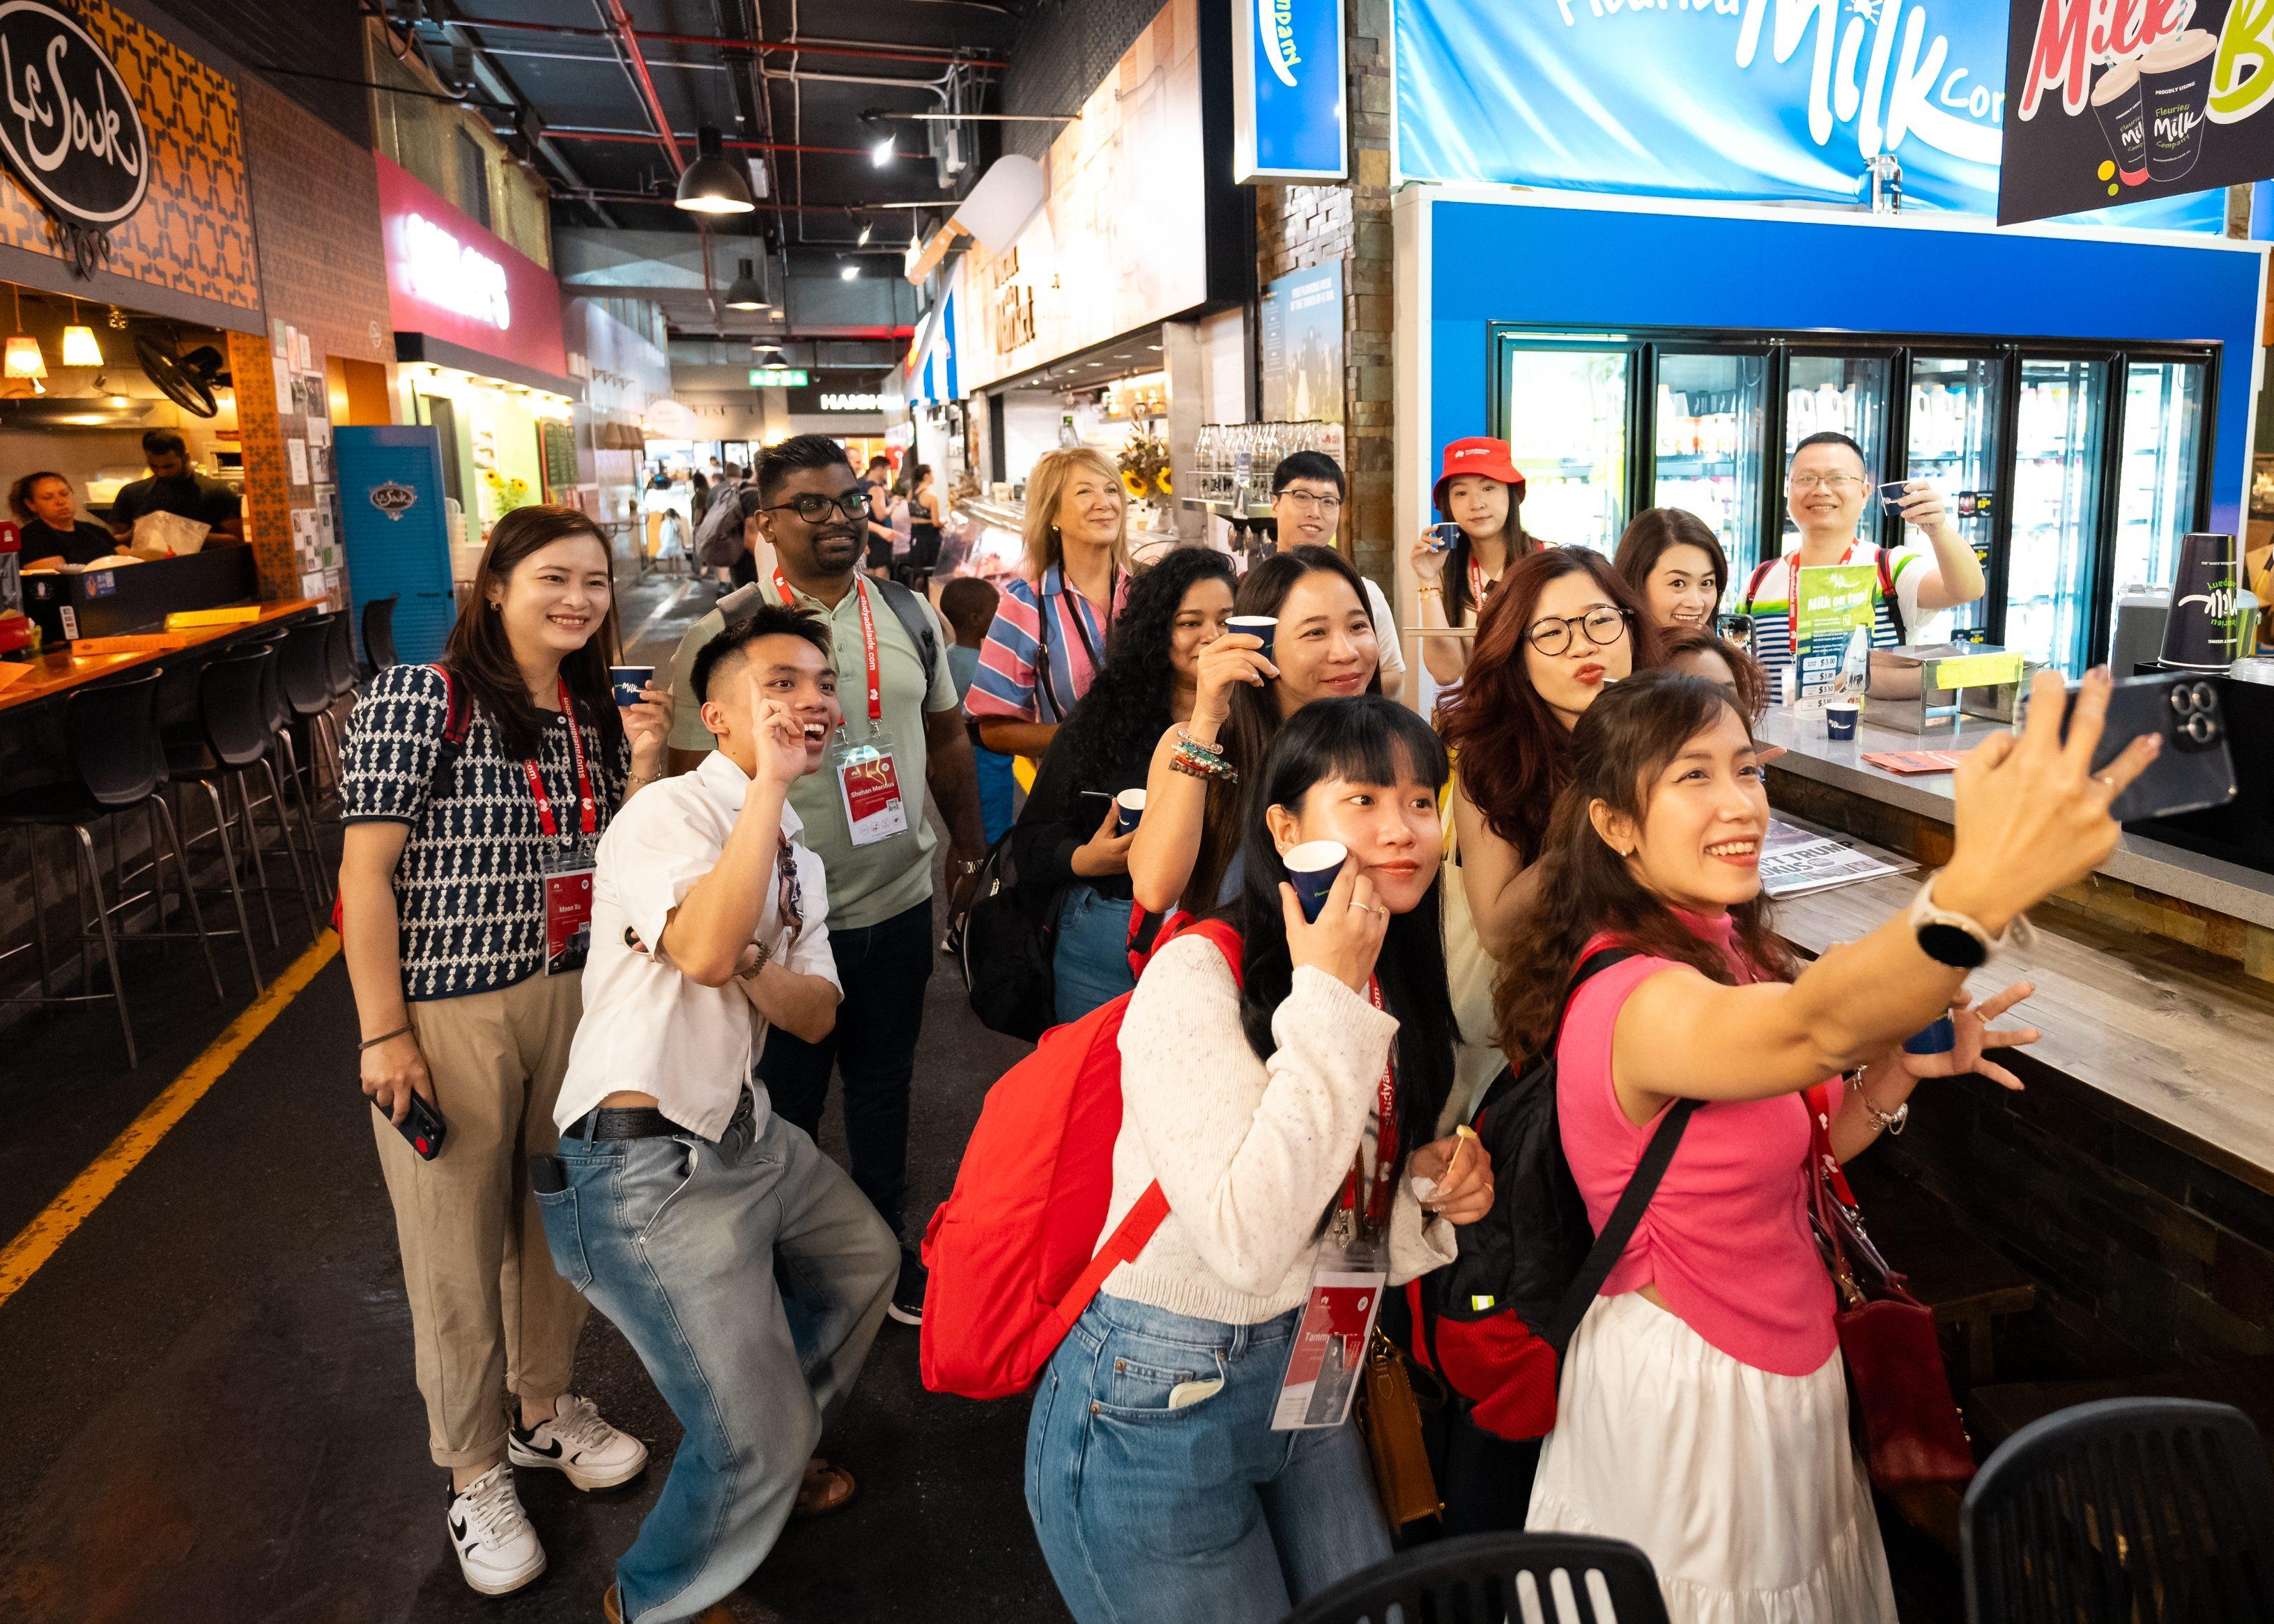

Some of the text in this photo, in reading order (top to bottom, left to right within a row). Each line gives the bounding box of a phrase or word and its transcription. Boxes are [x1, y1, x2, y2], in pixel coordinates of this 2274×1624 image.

[2019, 0, 2197, 121] Milk
[1735, 0, 2004, 166] Milk
[2155, 81, 2196, 95] PROUDLY USING
[1, 33, 139, 176] Le Souk
[2156, 104, 2190, 117] Fleurieu
[2154, 109, 2205, 141] Milk
[2156, 134, 2190, 150] Company
[1829, 573, 1861, 589] Milk
[1808, 589, 1868, 612] Milk on tap!
[860, 595, 876, 671] studyadelaide.com
[622, 682, 643, 693] Milk
[1829, 718, 1851, 729] Milk
[851, 787, 872, 798] Shehan
[1782, 841, 1854, 861] TRUMP
[1305, 1331, 1332, 1343] Tammy
